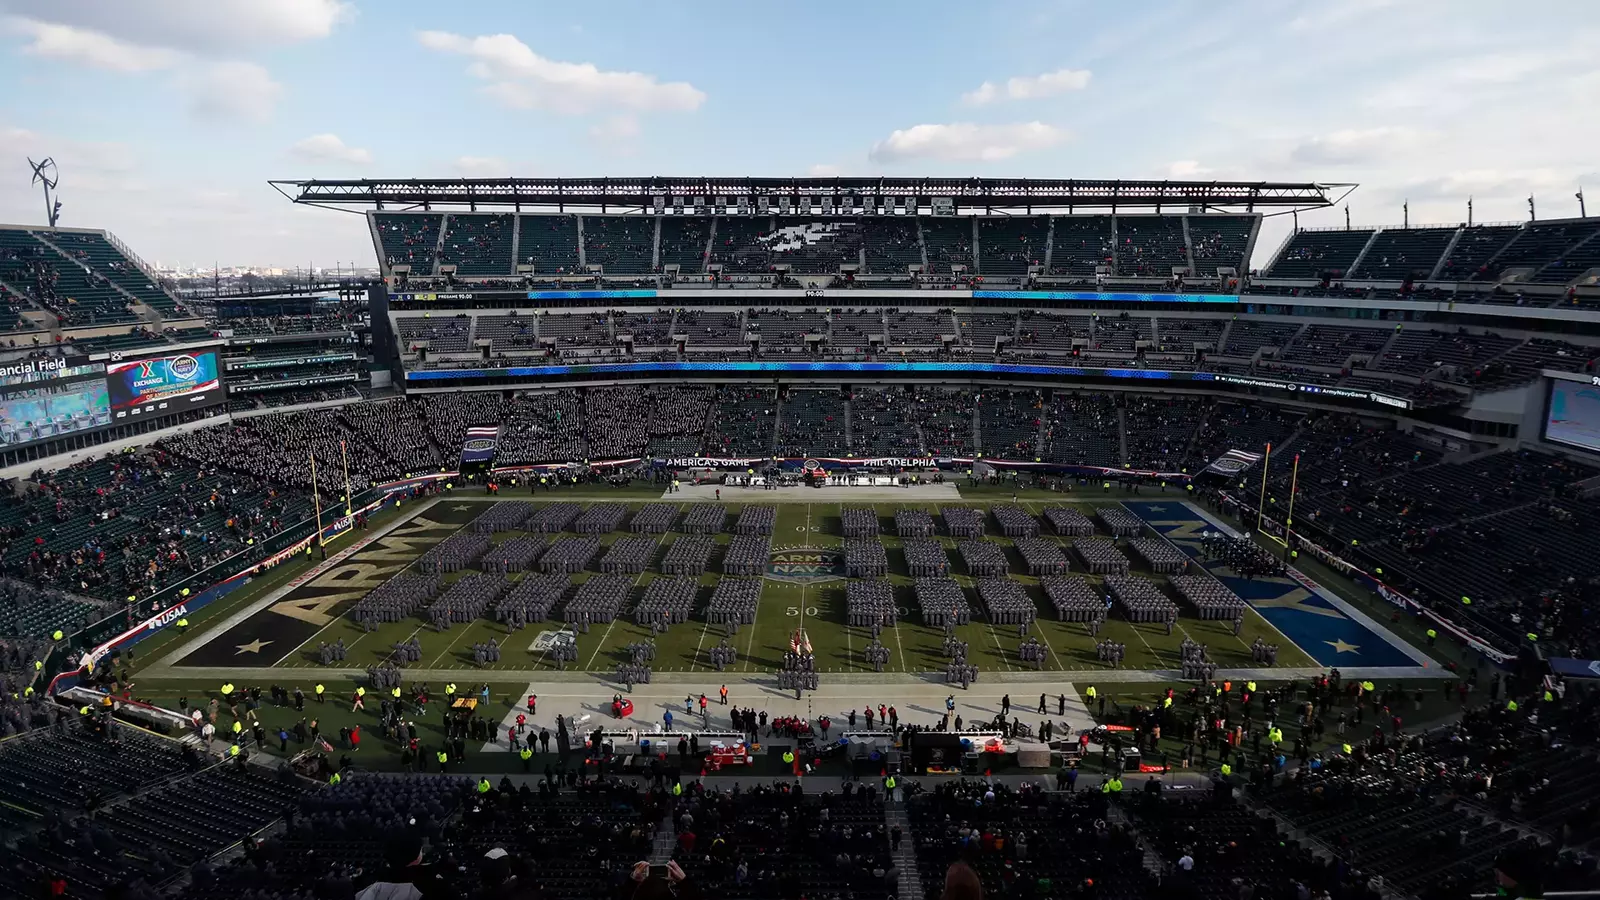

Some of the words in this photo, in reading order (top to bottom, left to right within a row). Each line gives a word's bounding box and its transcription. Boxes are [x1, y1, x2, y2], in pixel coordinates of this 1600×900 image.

[38, 357, 67, 371] Field
[133, 377, 163, 388] EXCHANGE
[1227, 377, 1287, 389] ArmyNavyFootballGame
[1322, 388, 1367, 398] ArmyNavyGame
[666, 458, 718, 467] AMERICA'S
[721, 458, 750, 467] GAME
[863, 458, 937, 467] PHILADELPHIA
[773, 554, 837, 562] ARMY
[773, 565, 837, 573] NAVY
[1327, 556, 1352, 574] NAVY
[268, 516, 464, 626] ARMY
[1386, 590, 1407, 609] USAA
[161, 604, 187, 625] USAA
[785, 606, 819, 617] 50
